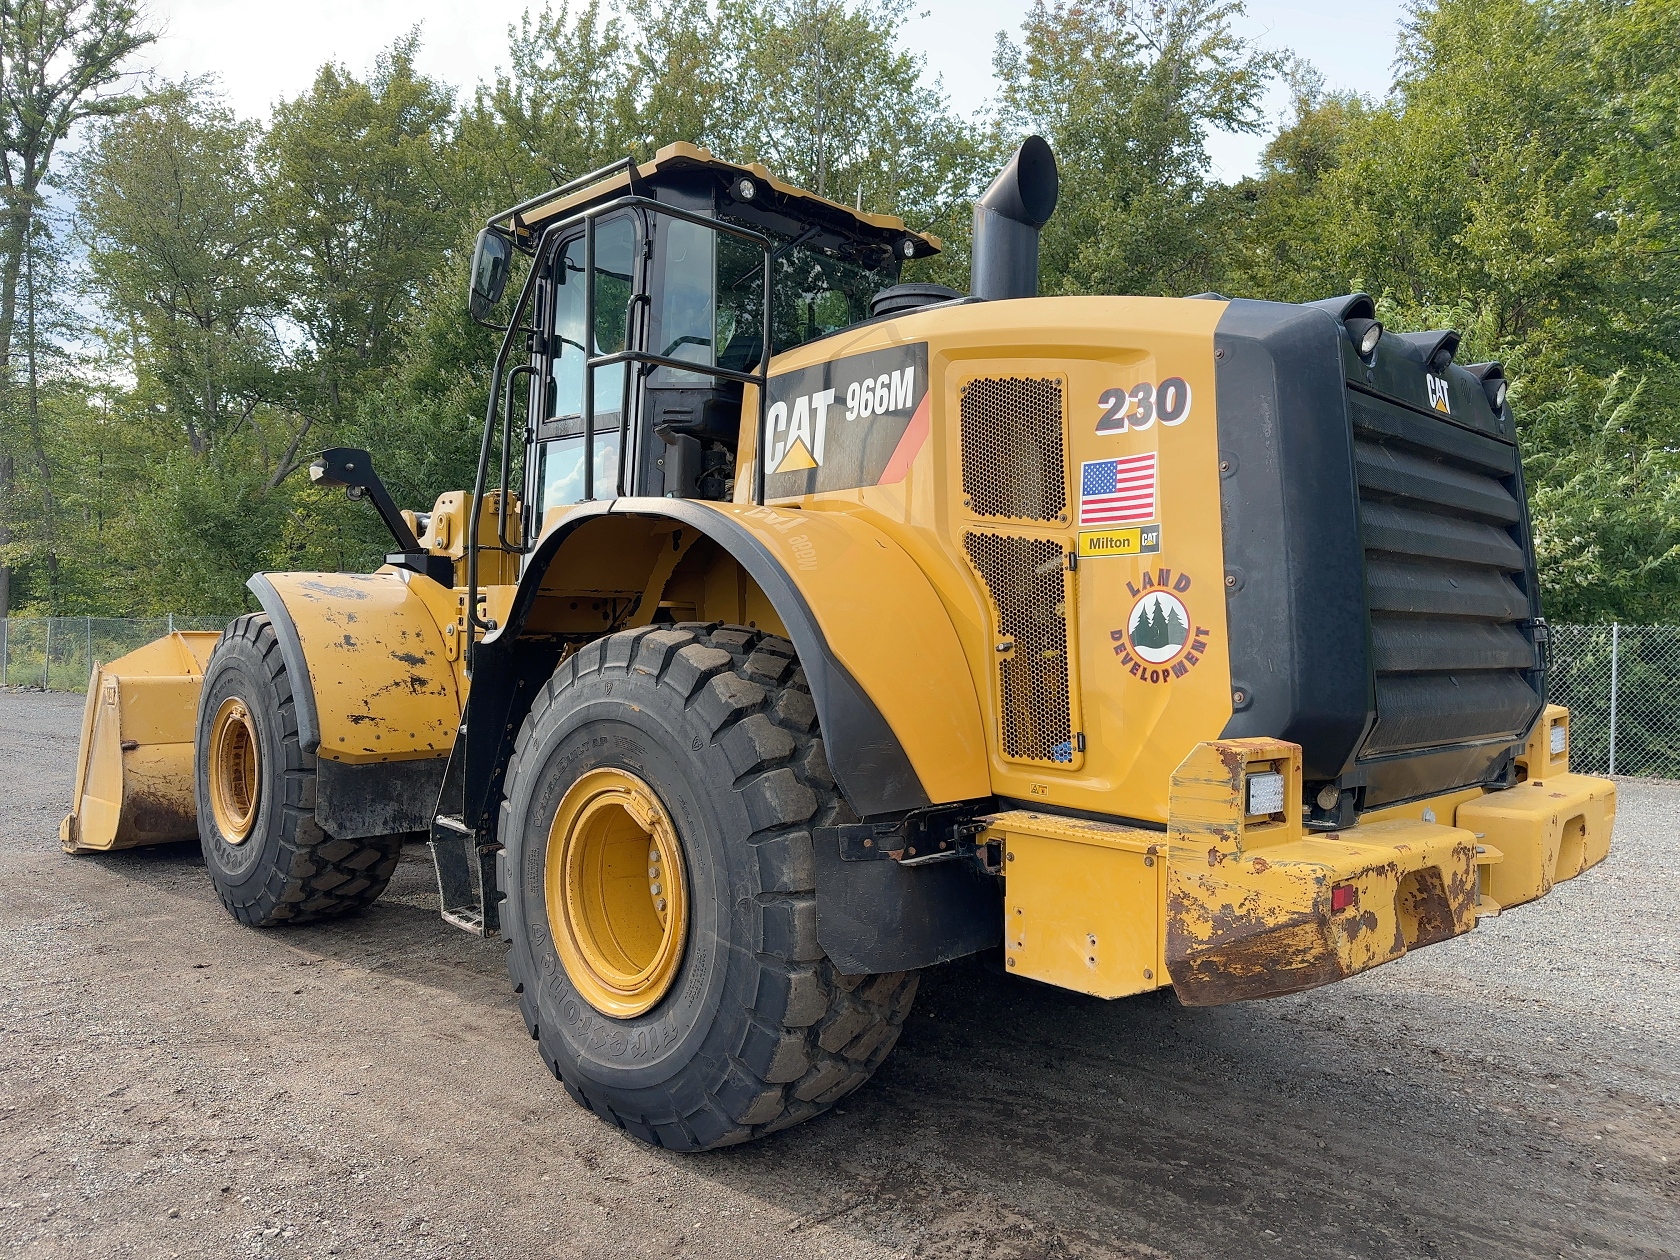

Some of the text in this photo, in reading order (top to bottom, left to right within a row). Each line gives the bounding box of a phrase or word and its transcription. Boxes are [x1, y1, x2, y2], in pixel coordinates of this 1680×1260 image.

[845, 366, 915, 421] 966M
[1095, 376, 1192, 436] 230
[1426, 373, 1450, 414] CAT
[765, 388, 835, 475] CAT
[1089, 537, 1131, 550] Milton
[1142, 532, 1158, 546] CAT
[1125, 567, 1192, 599] LAND
[1109, 625, 1211, 684] DEVELOPMENT
